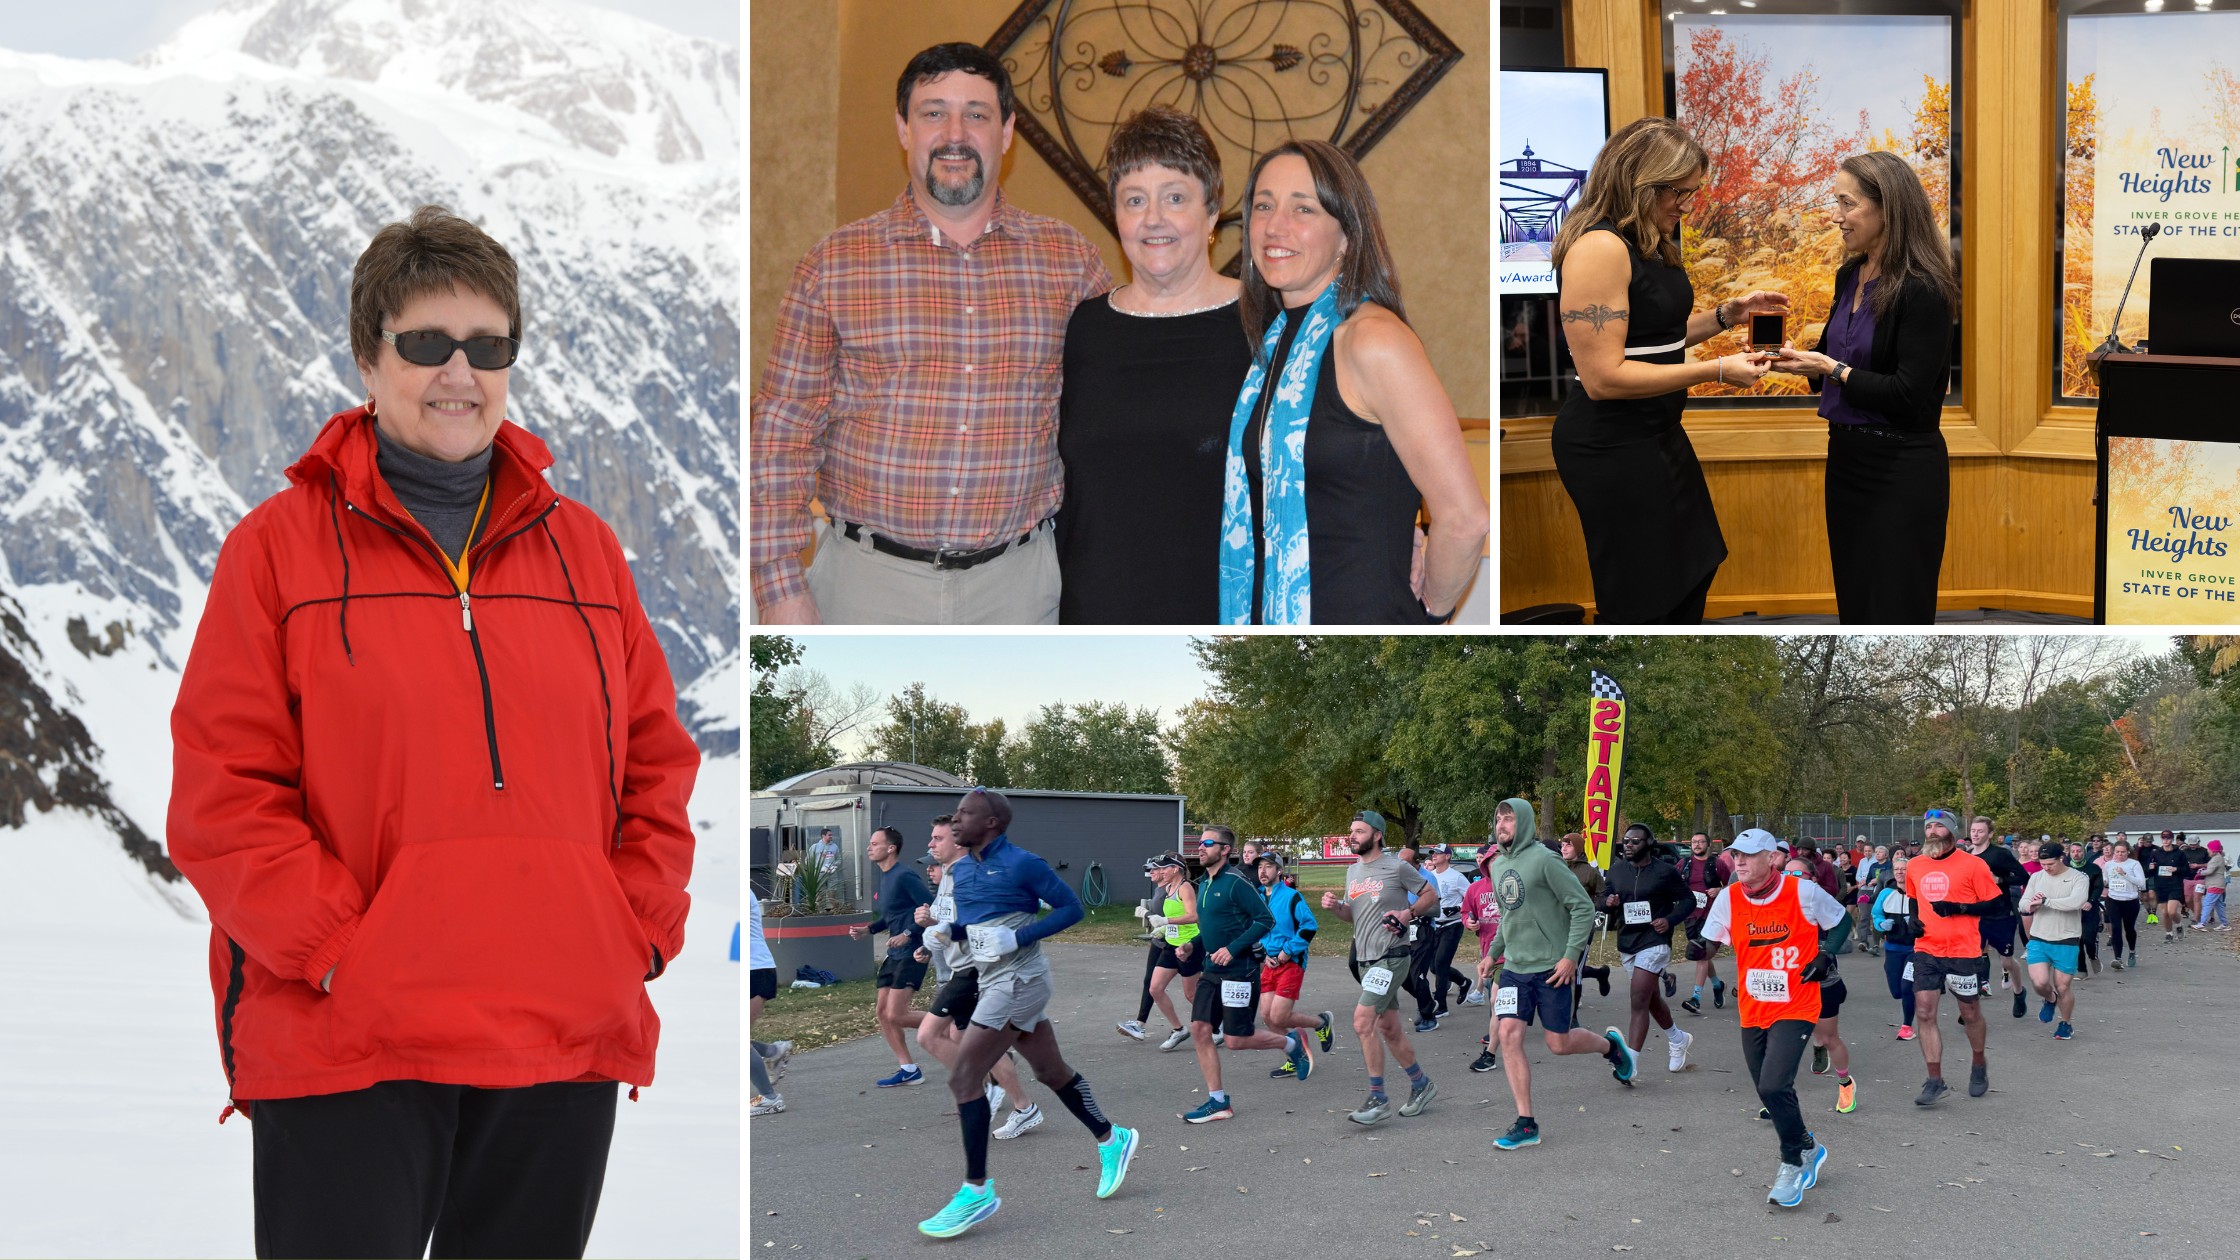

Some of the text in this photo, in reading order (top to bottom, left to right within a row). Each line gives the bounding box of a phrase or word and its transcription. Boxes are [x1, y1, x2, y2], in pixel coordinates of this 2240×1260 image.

[2157, 147, 2216, 168] New
[2119, 170, 2212, 202] Heights
[2174, 212, 2218, 220] GROVE
[2164, 226, 2183, 235] OF
[2189, 226, 2216, 236] THE
[2168, 506, 2233, 531] New
[2127, 529, 2228, 563] Heights
[2142, 570, 2235, 585] INVER GROVE
[2123, 582, 2235, 602] STATE OF THE
[1746, 921, 1789, 935] Dundas
[1771, 946, 1799, 969] 82
[1370, 976, 1389, 987] 2637
